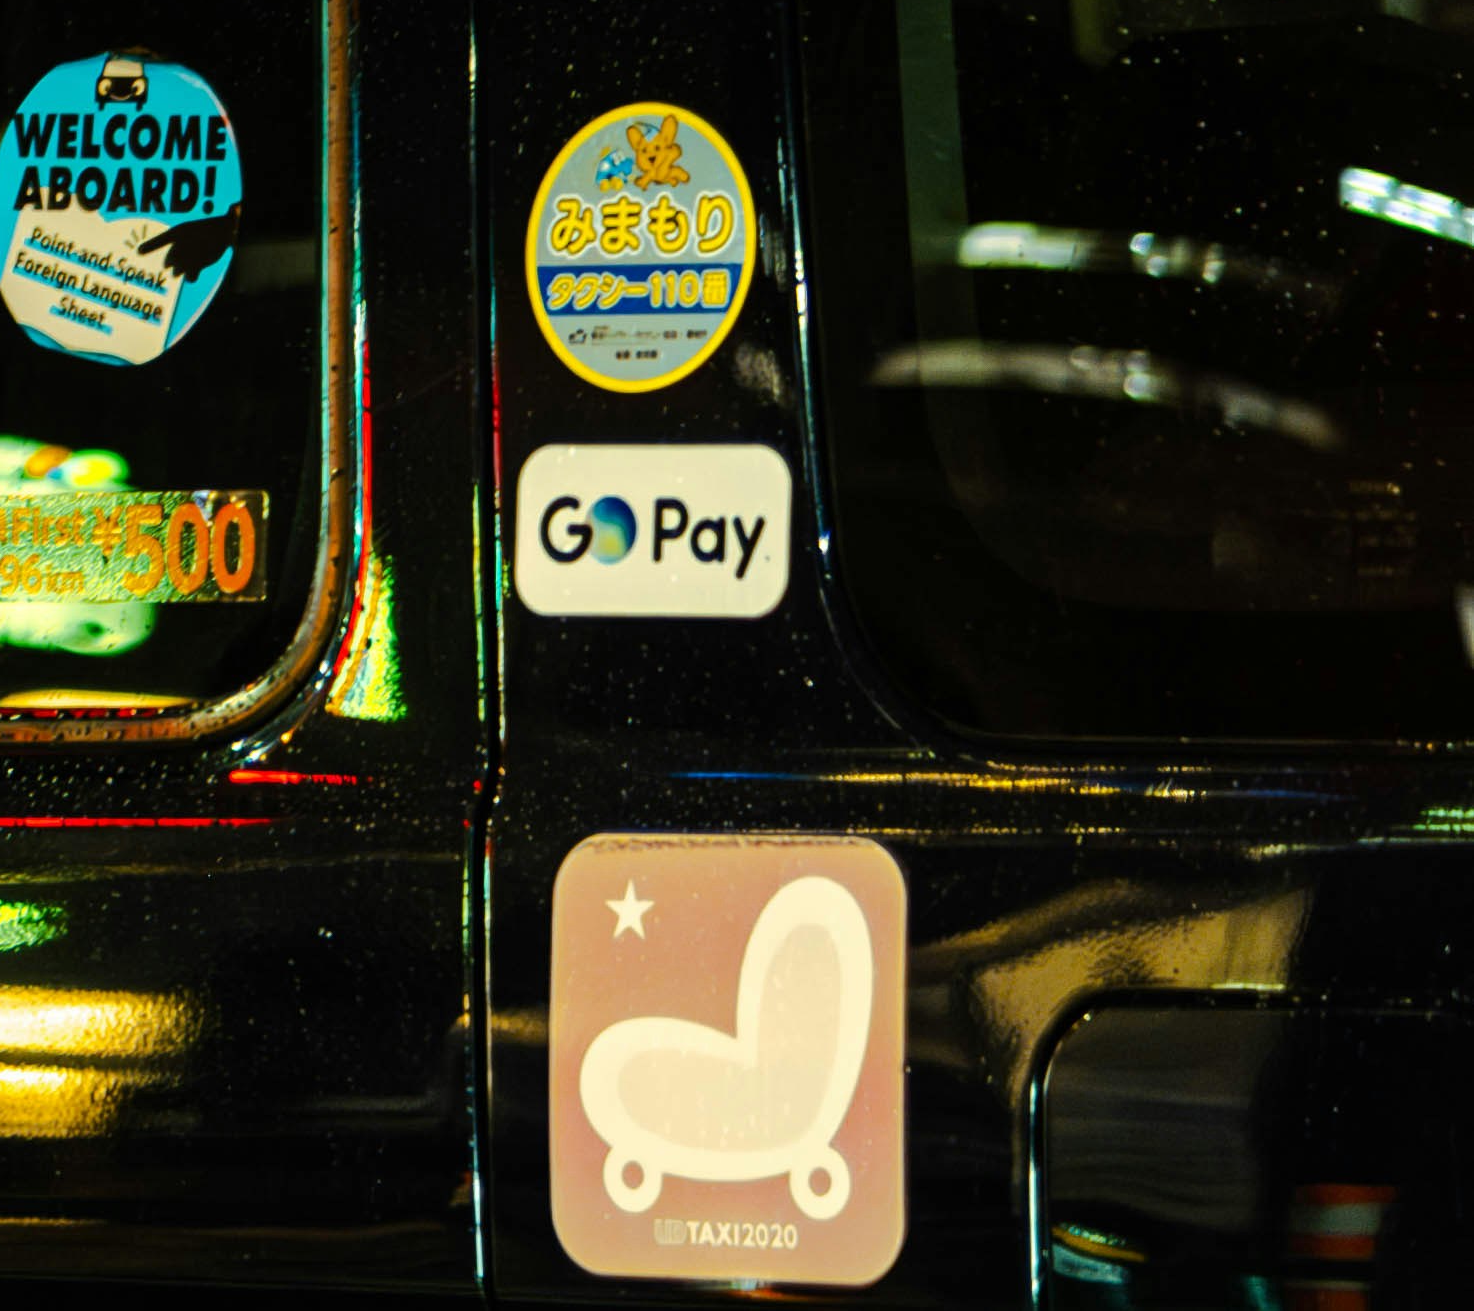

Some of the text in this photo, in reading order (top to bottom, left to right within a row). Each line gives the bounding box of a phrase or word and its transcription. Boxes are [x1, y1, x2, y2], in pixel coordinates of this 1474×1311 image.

[13, 112, 227, 161] WELCOME
[14, 165, 218, 215] ABOARD!
[549, 193, 735, 256] みまもり
[29, 227, 168, 291] Point-and-Speak
[14, 251, 164, 321] Foreign Language
[547, 270, 731, 310] タクシー110番
[58, 296, 107, 328] Sheet
[12, 505, 86, 547] First
[652, 496, 766, 581] Pay
